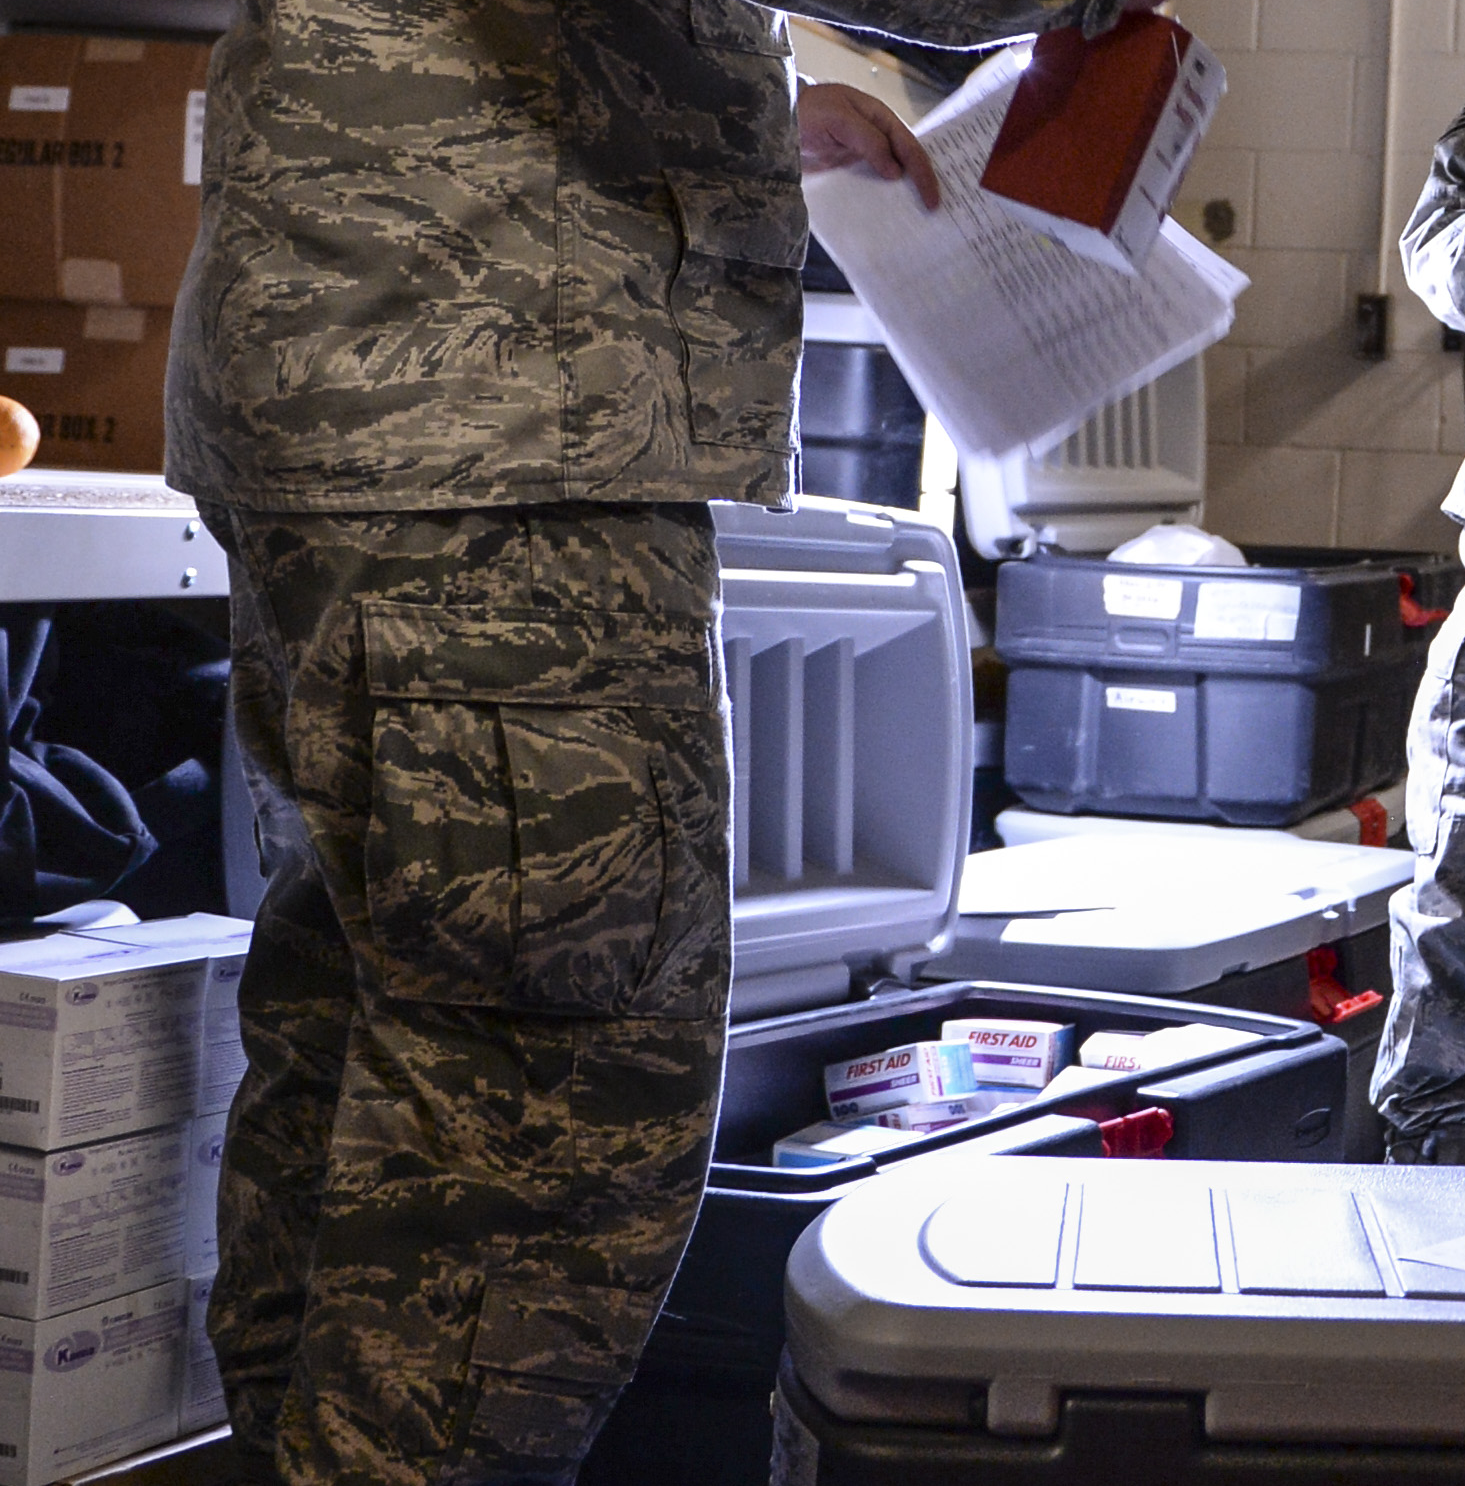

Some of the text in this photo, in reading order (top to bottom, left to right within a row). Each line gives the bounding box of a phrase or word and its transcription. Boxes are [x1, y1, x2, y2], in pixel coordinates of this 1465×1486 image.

[969, 1031, 1038, 1049] FIRST AID
[846, 1053, 912, 1080] FIRST AID
[1010, 1056, 1041, 1067] SHEER
[1104, 1055, 1142, 1070] FIRS
[889, 1073, 918, 1089] SHEER
